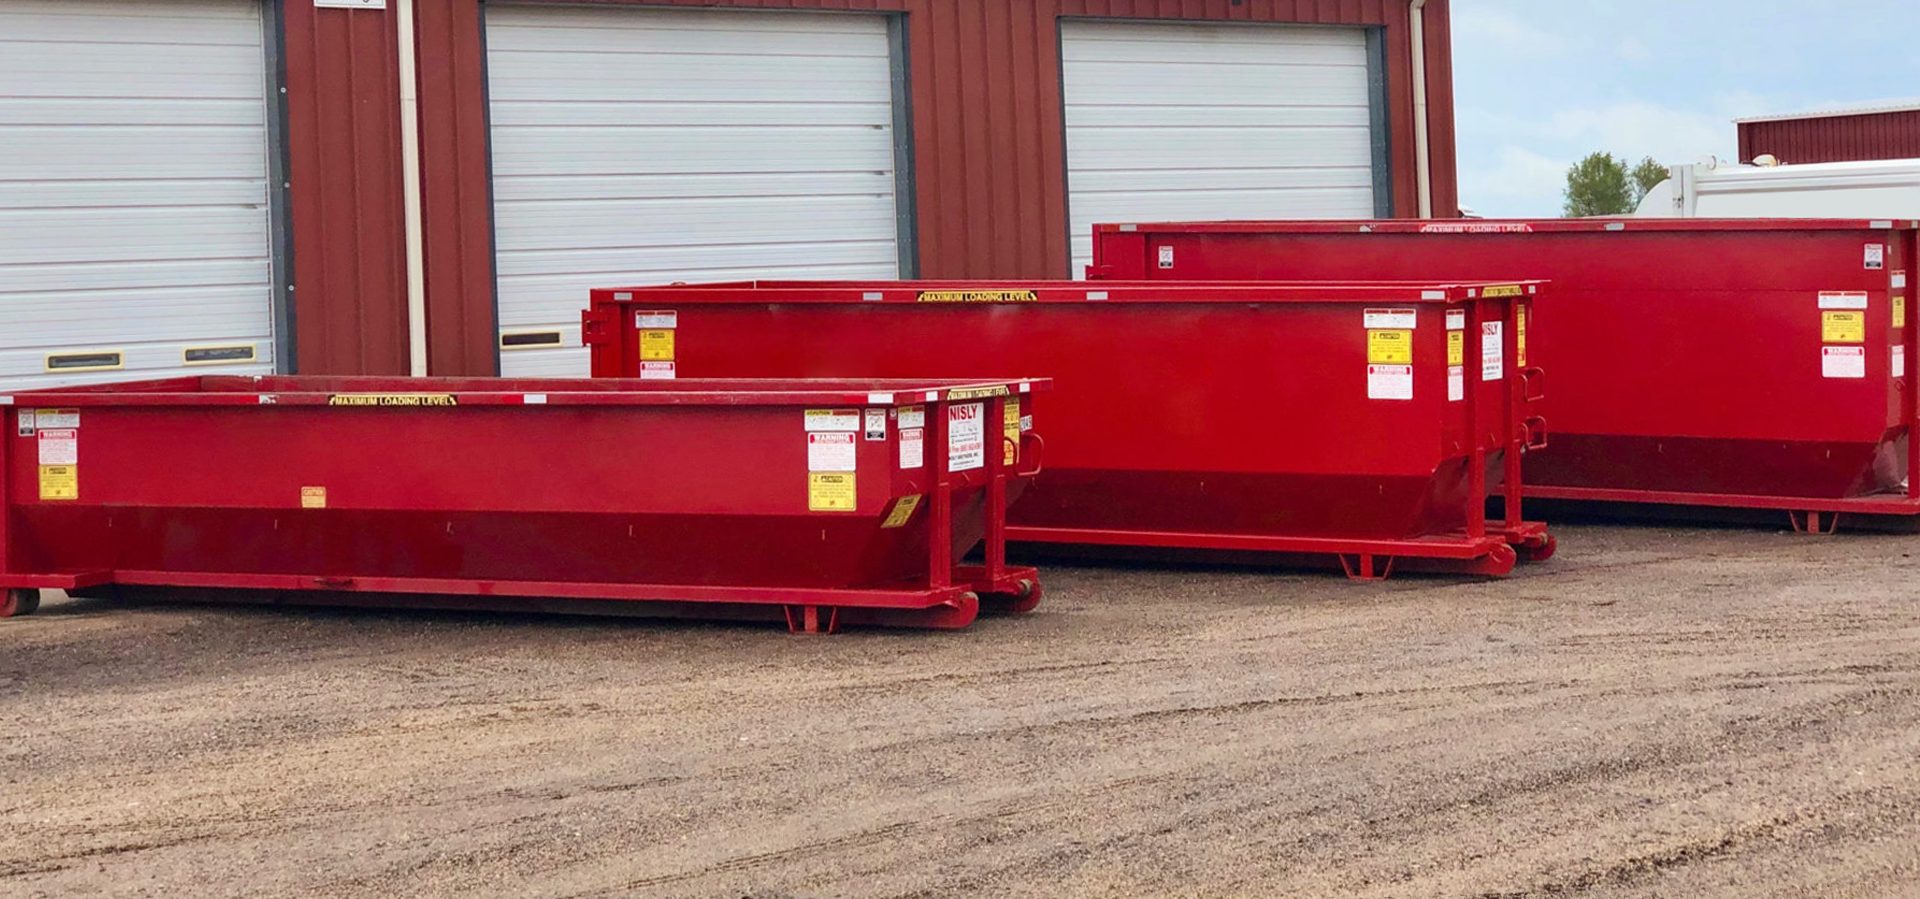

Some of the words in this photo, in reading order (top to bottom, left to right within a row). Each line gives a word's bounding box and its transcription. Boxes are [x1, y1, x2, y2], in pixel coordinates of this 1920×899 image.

[924, 292, 963, 301] MAXIMUM
[965, 292, 1003, 301] LOADING
[1004, 292, 1031, 301] LEVEL
[335, 397, 377, 405] MAXIMUM
[379, 397, 420, 405] LOADING
[422, 397, 450, 405] LEVEL
[950, 404, 978, 421] NISLY
